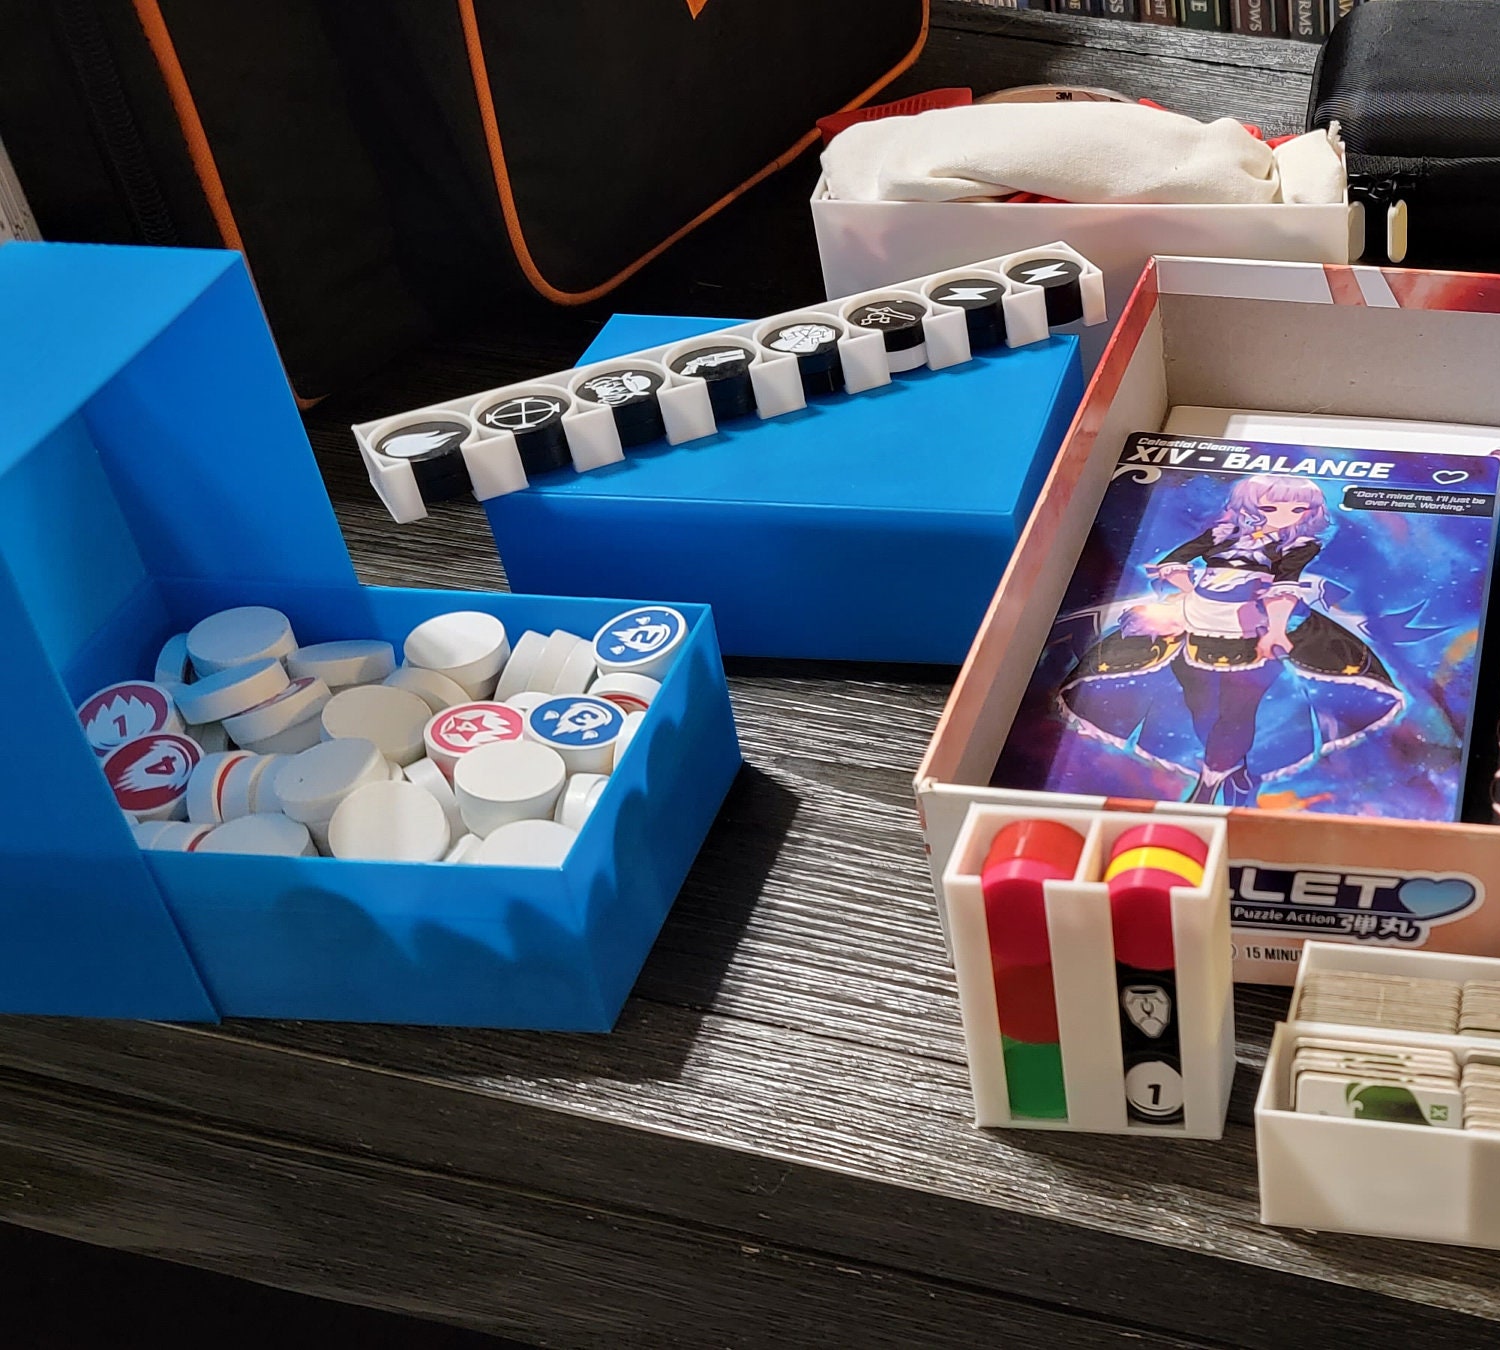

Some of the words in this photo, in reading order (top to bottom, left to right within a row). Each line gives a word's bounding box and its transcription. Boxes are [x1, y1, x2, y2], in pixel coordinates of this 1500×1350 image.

[1055, 91, 1073, 101] 3M
[1137, 437, 1197, 449] Celestial
[1197, 442, 1251, 453] Cleaner
[1126, 445, 1196, 465] XIV
[1221, 452, 1396, 480] BALANCE
[1449, 496, 1470, 504] just
[112, 714, 127, 738] 1
[1231, 867, 1400, 910] LET
[1234, 906, 1284, 921] Puzzle
[1286, 911, 1336, 926] Action
[1245, 946, 1261, 960] 15
[1147, 1083, 1162, 1106] 1
